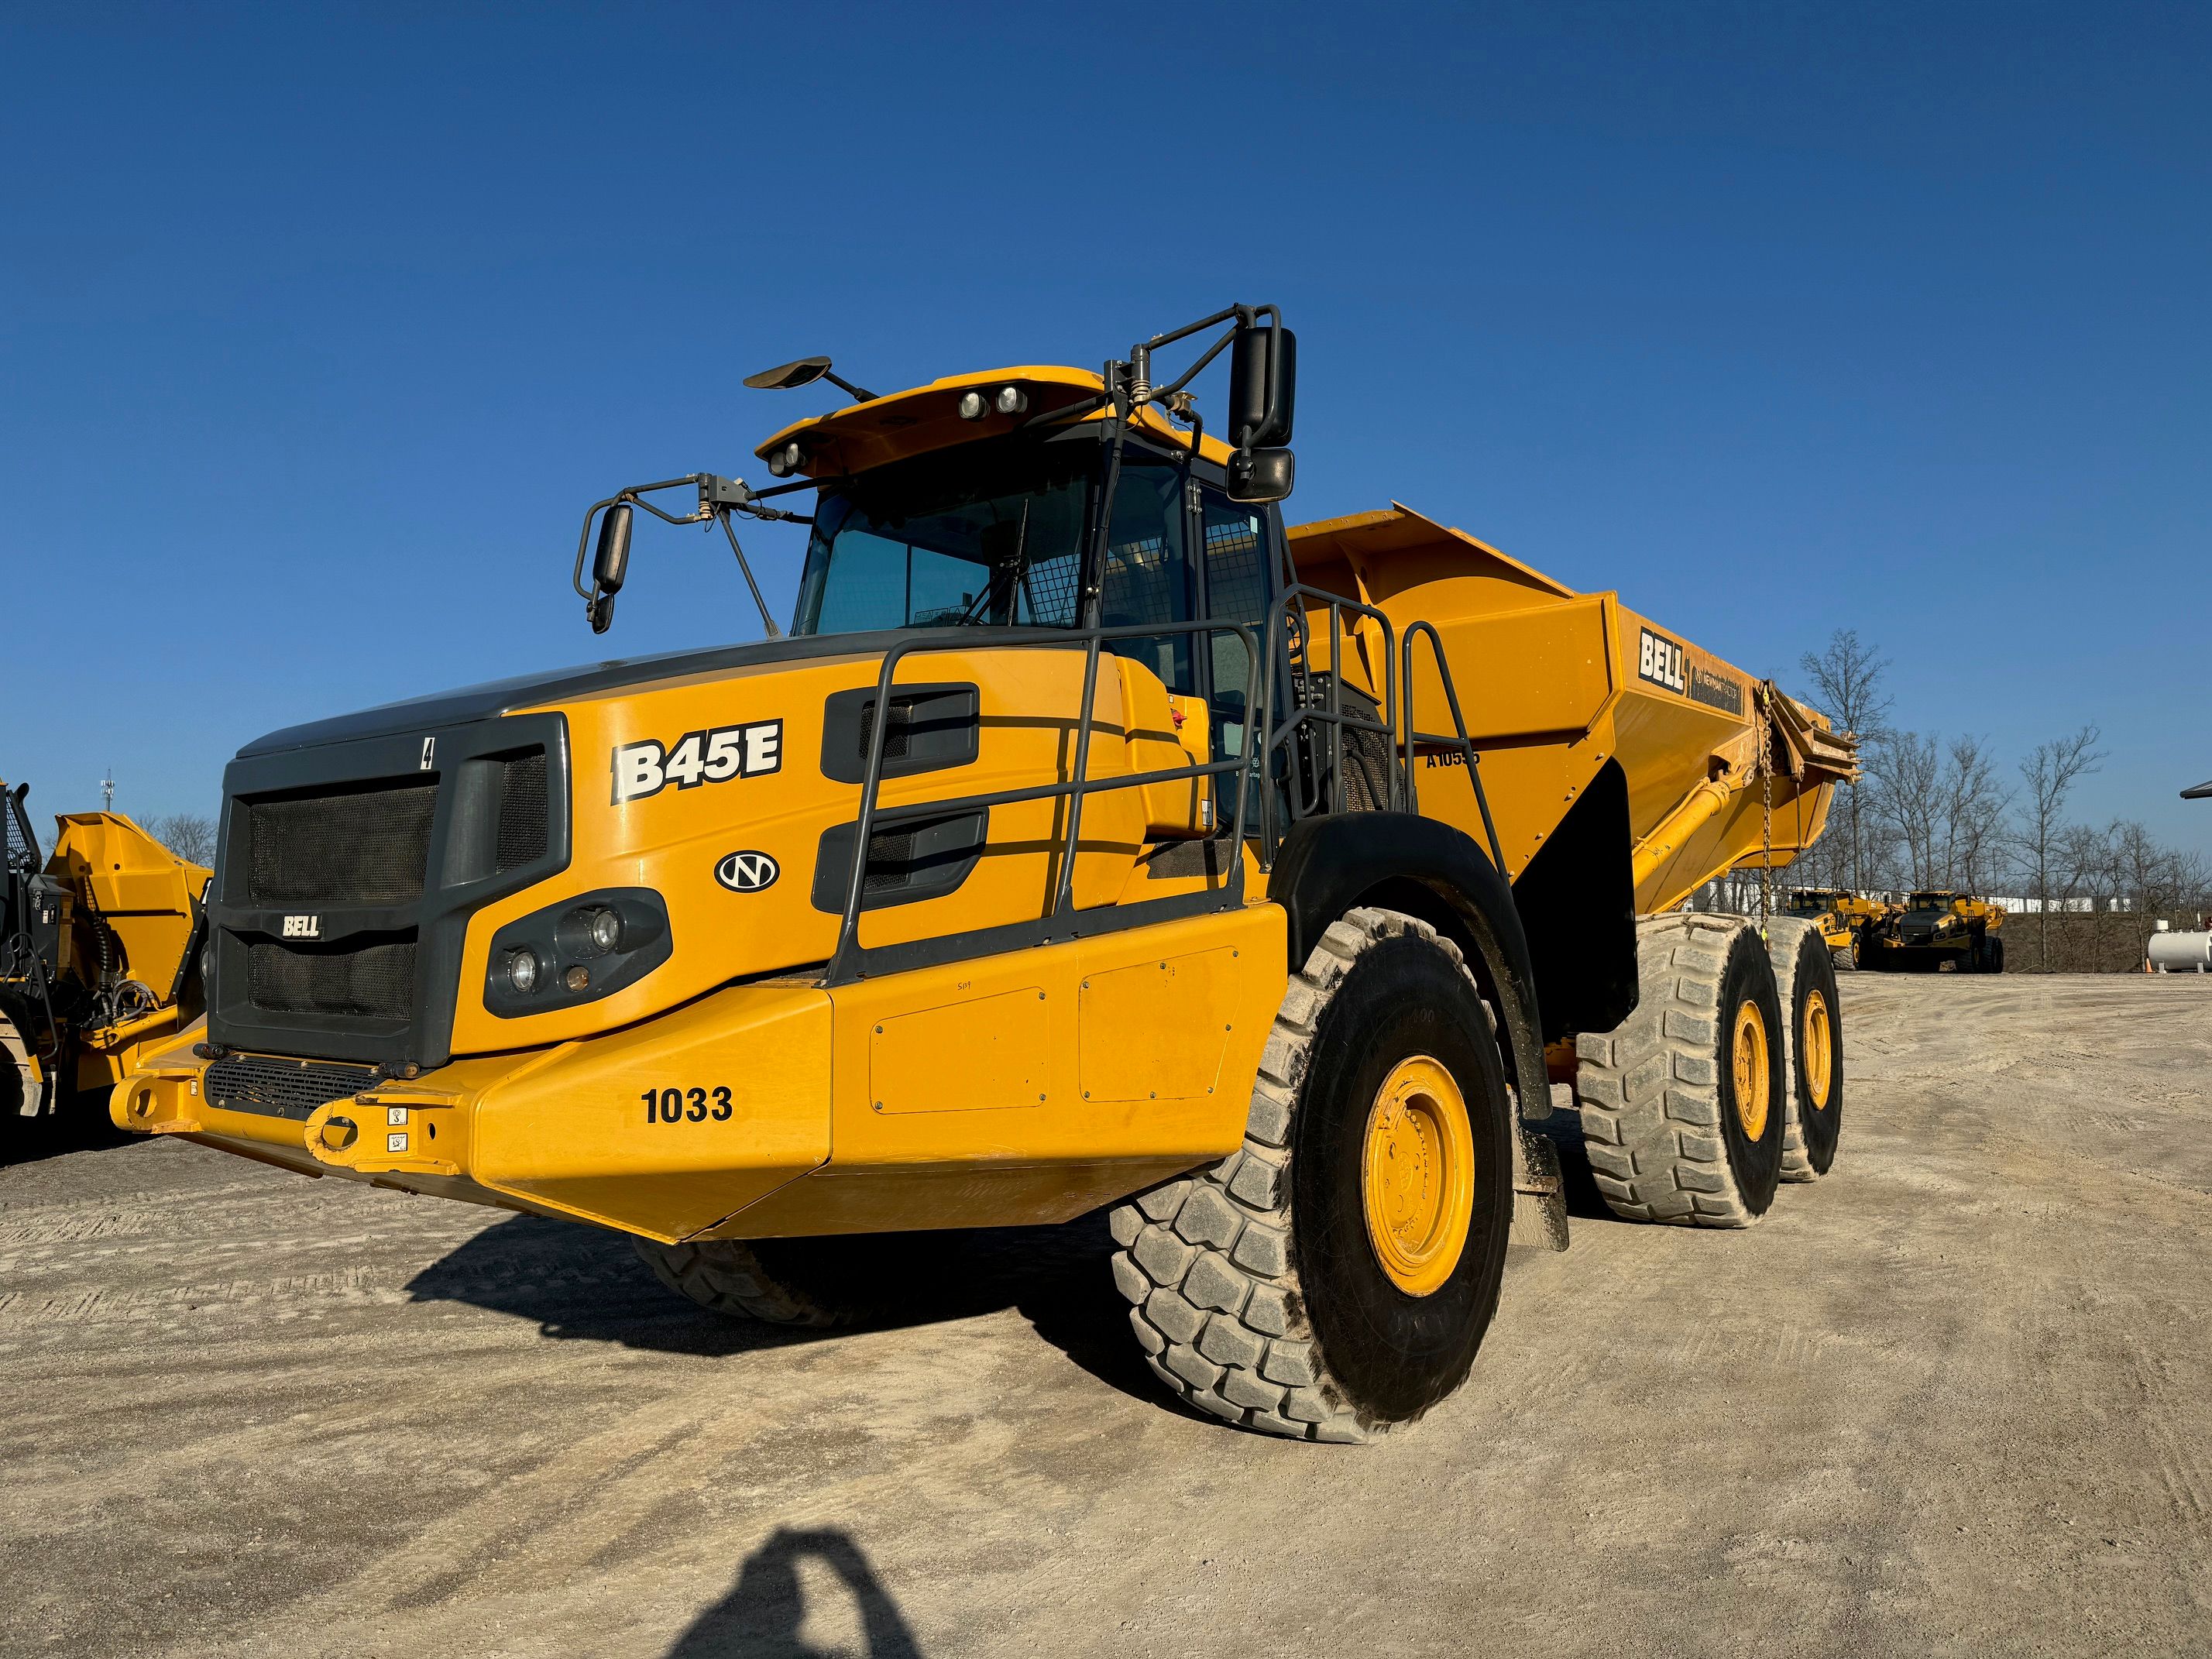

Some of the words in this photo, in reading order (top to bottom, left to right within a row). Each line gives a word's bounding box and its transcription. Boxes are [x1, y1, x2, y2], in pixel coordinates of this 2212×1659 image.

[1639, 629, 1685, 693] BELL
[423, 738, 433, 768] 4
[613, 720, 781, 803] B45E
[282, 915, 319, 937] BELL
[641, 1086, 733, 1124] 1033
